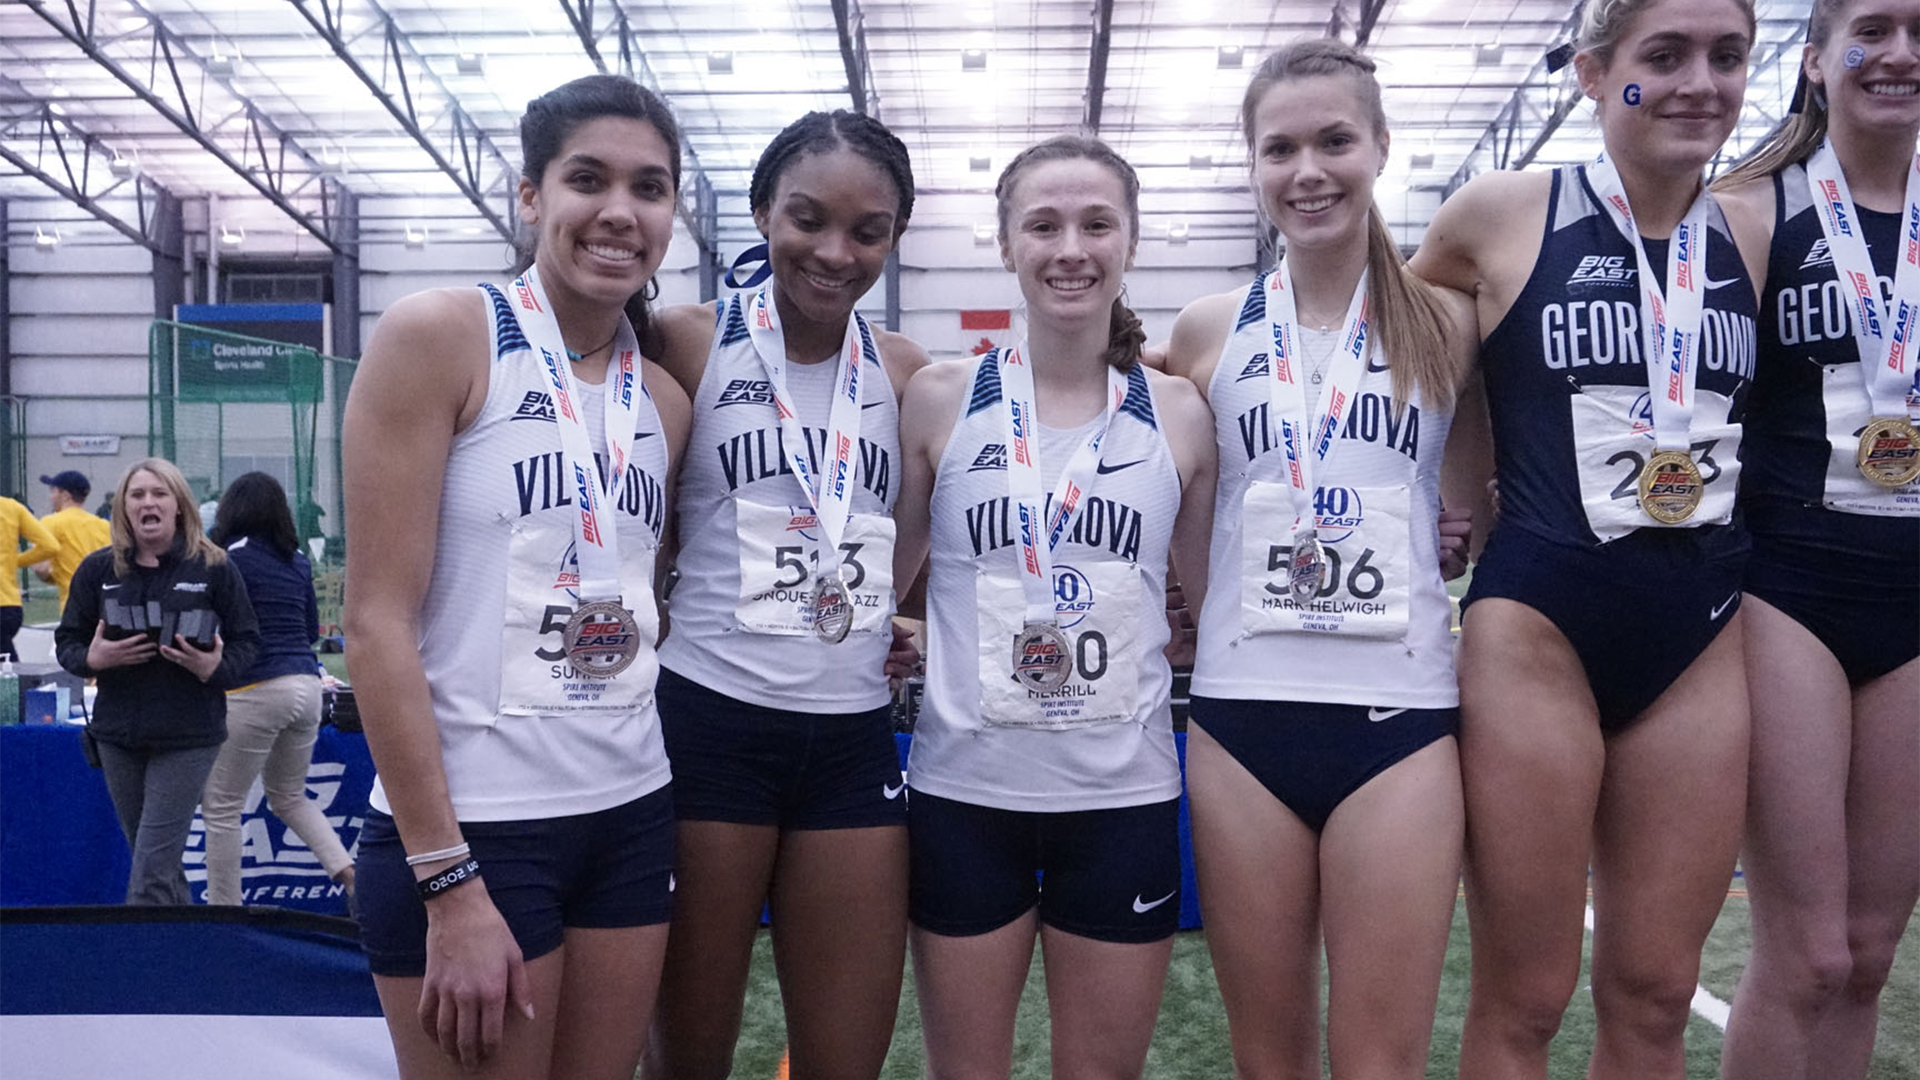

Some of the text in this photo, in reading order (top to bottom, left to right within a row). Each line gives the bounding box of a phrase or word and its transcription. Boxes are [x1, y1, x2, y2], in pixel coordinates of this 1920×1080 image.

[1843, 45, 1865, 69] G
[1622, 83, 1641, 106] G
[1825, 179, 1853, 238] BIG EAST
[1578, 255, 1625, 268] BIG
[1677, 223, 1690, 289] BIG EAST
[1907, 238, 1918, 265] BIG
[1571, 267, 1638, 280] EAST
[517, 287, 534, 310] BIG
[1855, 272, 1882, 340] BIG EAST
[1541, 299, 1757, 381] GEOROWN
[1888, 299, 1909, 370] BIG EAST
[213, 344, 273, 356] Cleveland
[1273, 323, 1287, 383] BIG EAST
[1668, 327, 1684, 402] BIG EAST
[540, 346, 571, 420] BIG EAST
[621, 350, 633, 412] BIG EAST
[726, 380, 770, 391] BIG
[848, 365, 859, 404] EAST
[1011, 399, 1025, 465] BIG EAST
[1318, 391, 1346, 461] BIG EAST
[980, 444, 1007, 455] BI
[1282, 419, 1300, 488] BIG EAST
[1875, 438, 1911, 449] BIG
[834, 434, 850, 501] BIG EAST
[1605, 439, 1722, 501] 23
[1655, 472, 1690, 484] BIG
[573, 461, 595, 544] BIG EAST
[1066, 486, 1081, 515] BIG
[1313, 486, 1349, 516] 40
[1650, 484, 1699, 494] EAST
[789, 516, 817, 525] BIG
[1322, 517, 1364, 526] EAST
[1019, 502, 1036, 576] BIG EAST
[1264, 545, 1384, 600] 506
[1055, 602, 1095, 611] EAST
[575, 634, 633, 646] EAST
[582, 622, 622, 635] BIG
[1021, 655, 1065, 665] EAST
[1026, 643, 1057, 655] BIG
[430, 868, 466, 891] 2020
